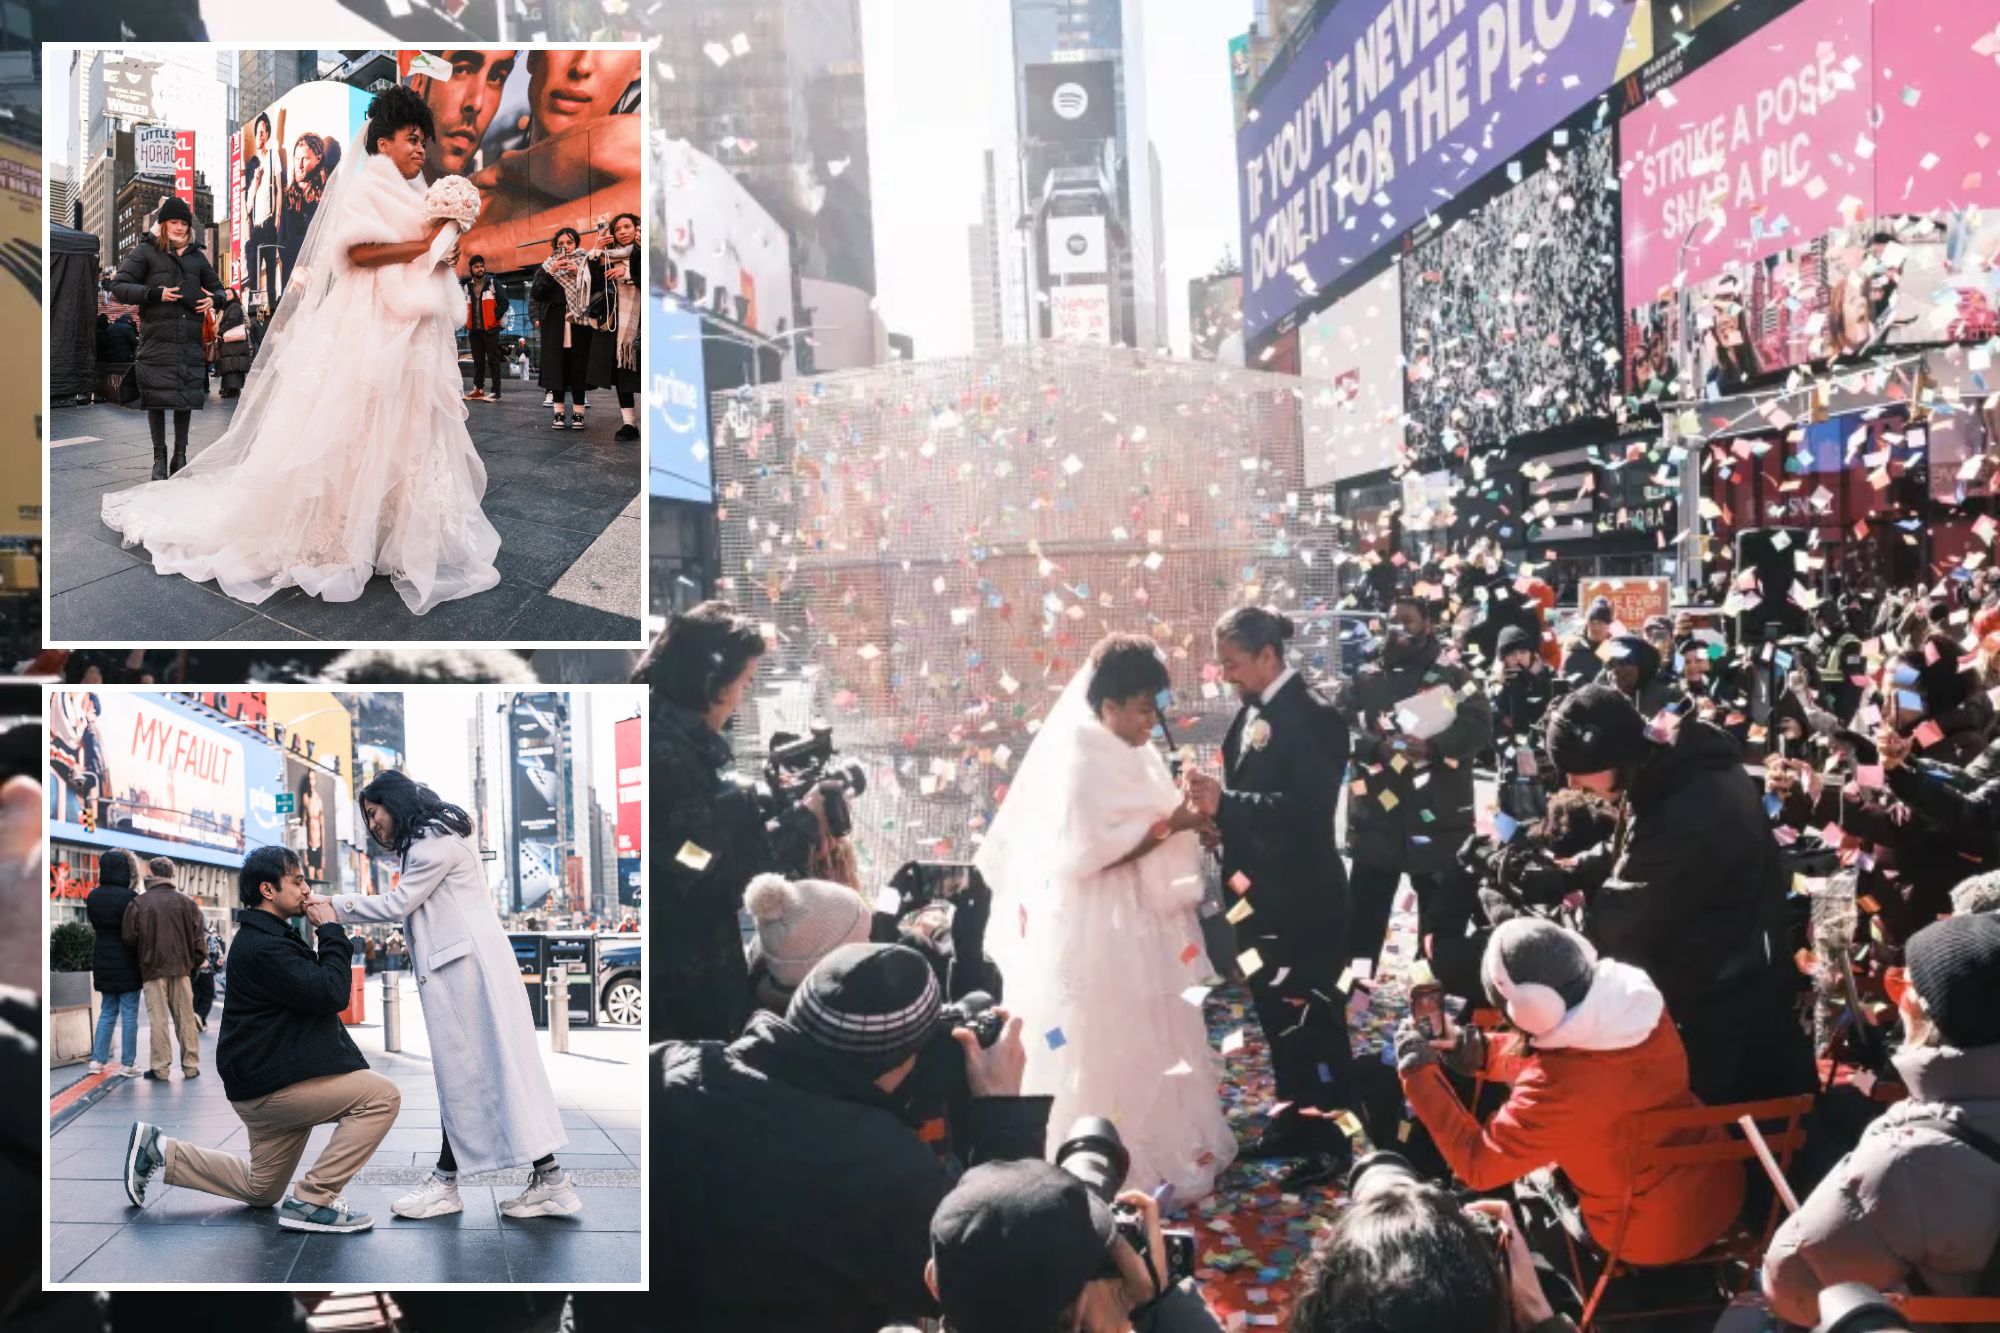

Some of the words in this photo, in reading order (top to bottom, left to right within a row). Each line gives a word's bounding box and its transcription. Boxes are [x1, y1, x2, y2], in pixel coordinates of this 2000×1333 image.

[141, 129, 170, 142] LITTLE
[141, 144, 177, 168] HORRO
[1248, 153, 1263, 225] IF
[1266, 53, 1351, 200] YOU'VE
[1251, 187, 1308, 293] DONE
[1310, 163, 1331, 244] IT
[1335, 109, 1394, 223] FOR
[1400, 29, 1469, 166] THE
[1478, 0, 1600, 107] PLO
[1642, 114, 1727, 196] STRIKE
[1730, 104, 1751, 152] A
[1757, 54, 1837, 138] POSE
[1662, 172, 1730, 239] SNAP
[1735, 161, 1756, 209] A
[1762, 132, 1811, 196] PIC
[131, 711, 172, 764] MY
[173, 729, 233, 786] FAULT
